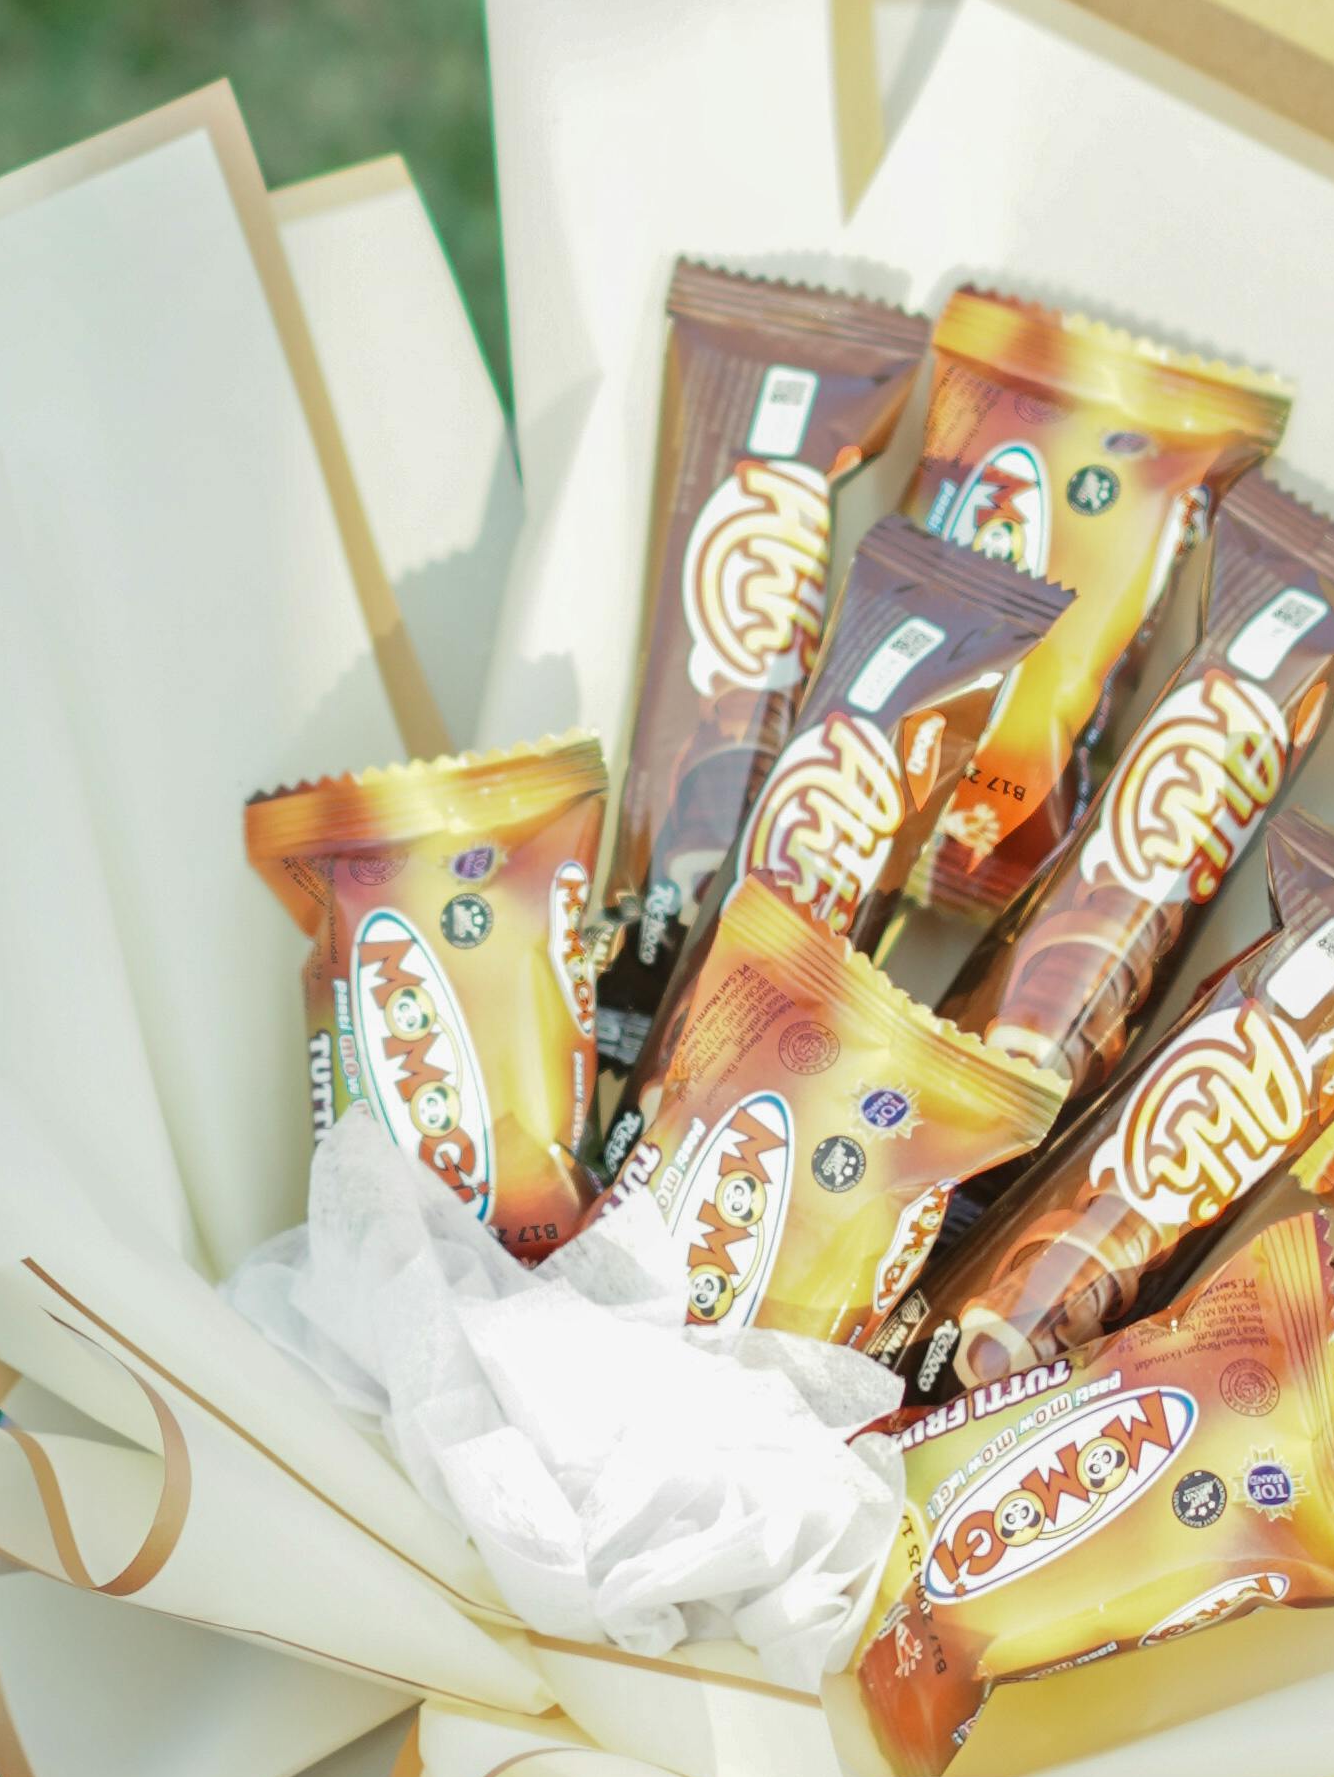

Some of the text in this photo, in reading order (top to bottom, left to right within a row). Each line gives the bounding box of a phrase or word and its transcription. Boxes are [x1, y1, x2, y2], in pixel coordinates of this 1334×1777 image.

[329, 977, 350, 1031] pasti
[1213, 1277, 1255, 1293] PT. Sari
[877, 1322, 908, 1365] HALA
[970, 1357, 1072, 1417] TUTTI
[1071, 1368, 1123, 1408] pasti
[1014, 1390, 1073, 1435] mow
[964, 1426, 1017, 1475] mow
[1248, 1473, 1284, 1484] BRAND
[1251, 1482, 1288, 1501] TOP
[928, 1634, 946, 1674] B17
